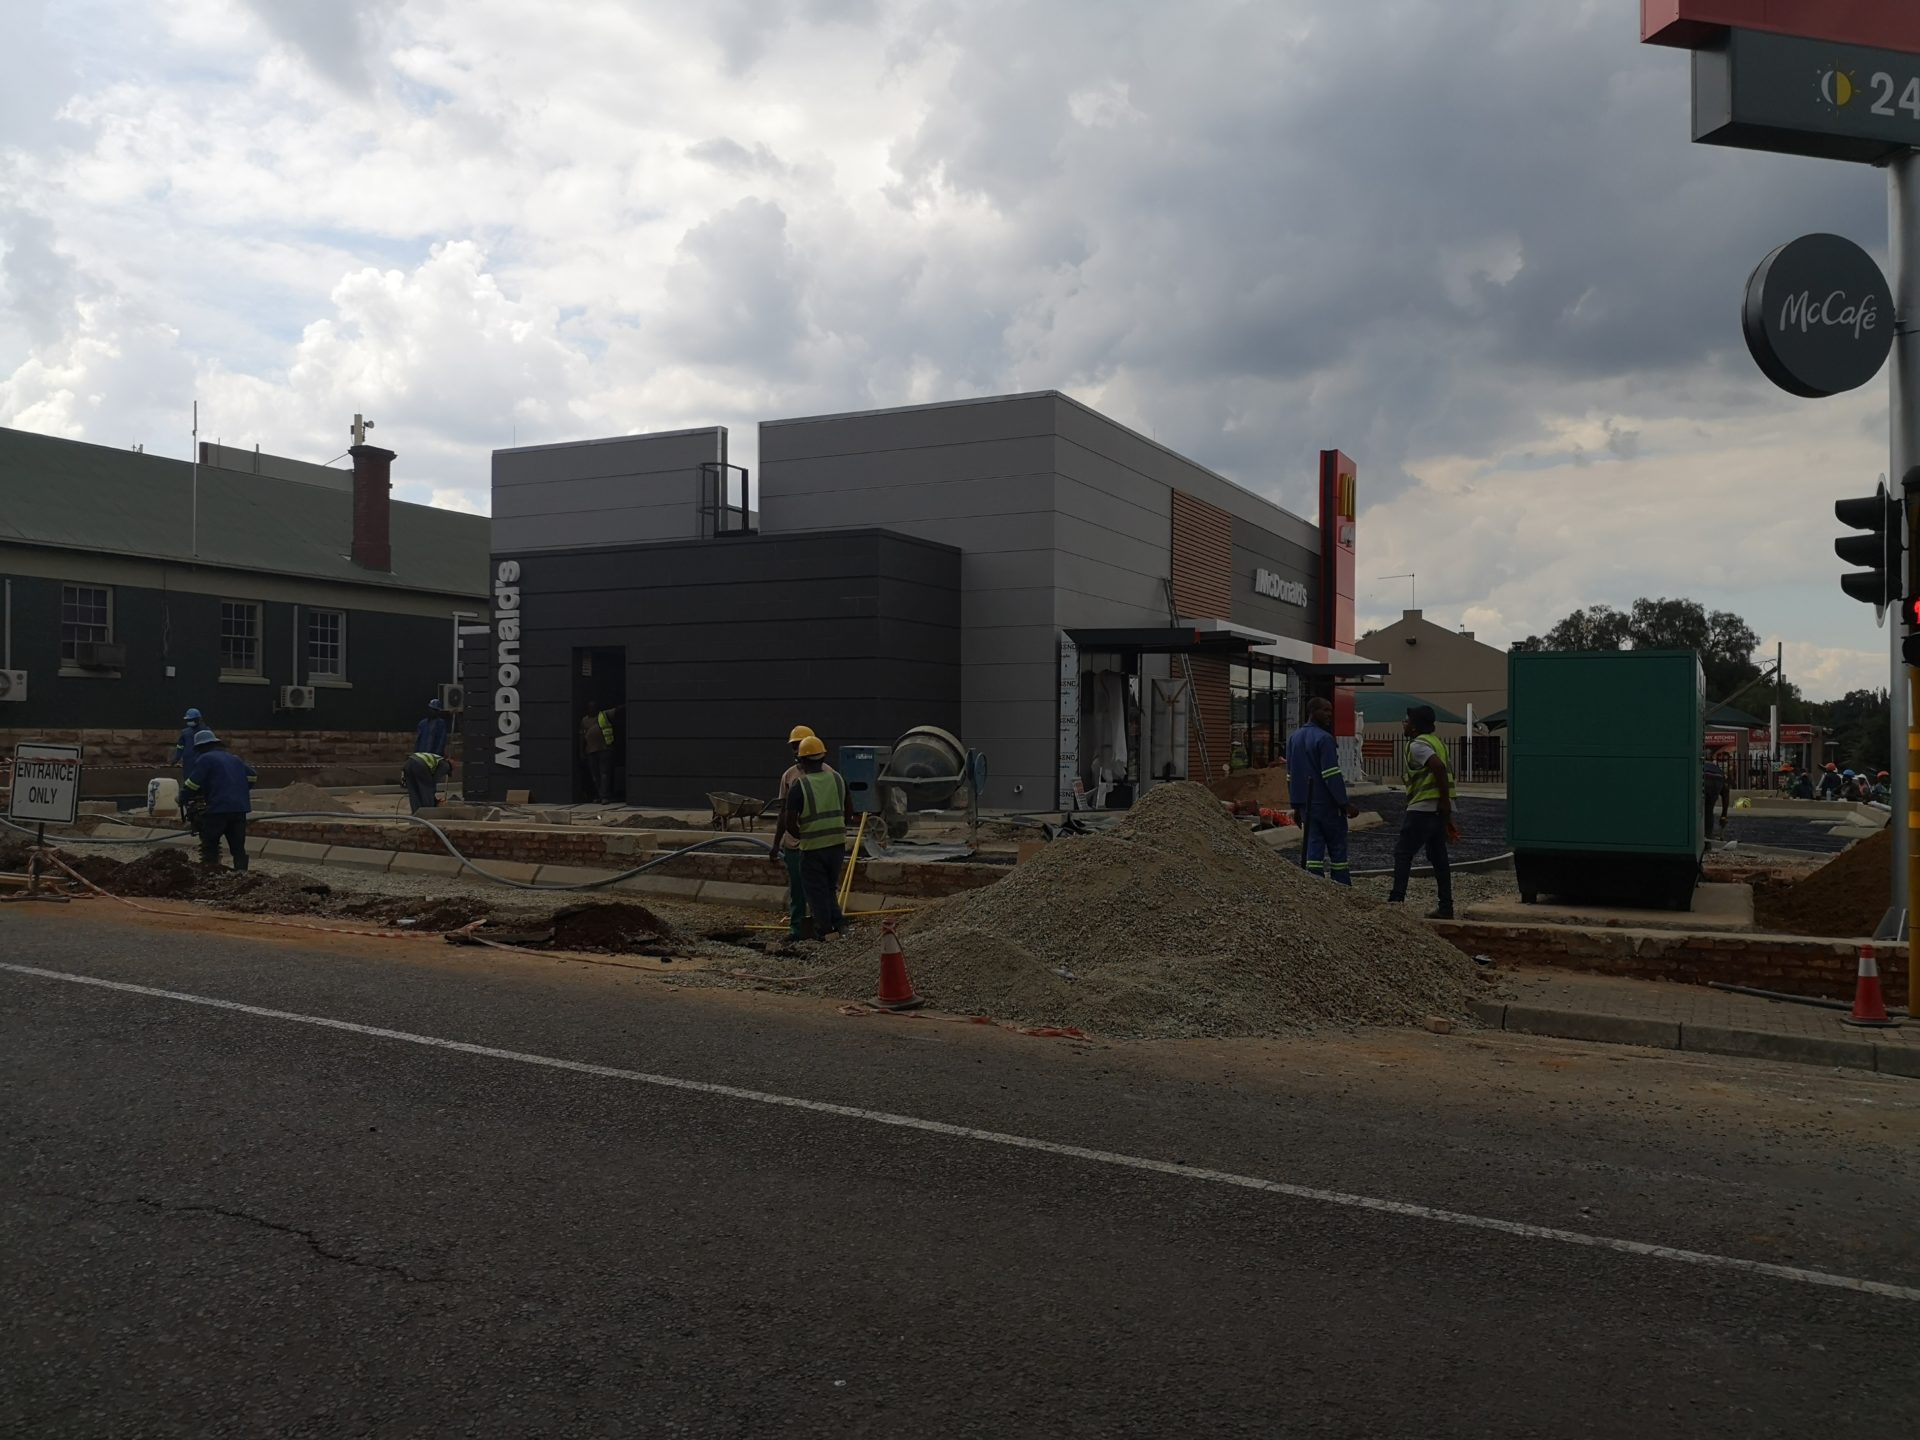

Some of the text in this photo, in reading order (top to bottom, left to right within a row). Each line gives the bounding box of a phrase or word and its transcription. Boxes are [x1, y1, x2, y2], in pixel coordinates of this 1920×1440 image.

[1870, 72, 1920, 120] 24
[1780, 290, 1877, 339] McCafé
[495, 561, 520, 769] McDonald's
[17, 762, 74, 782] ENTRANCE
[29, 786, 58, 804] ONLY
